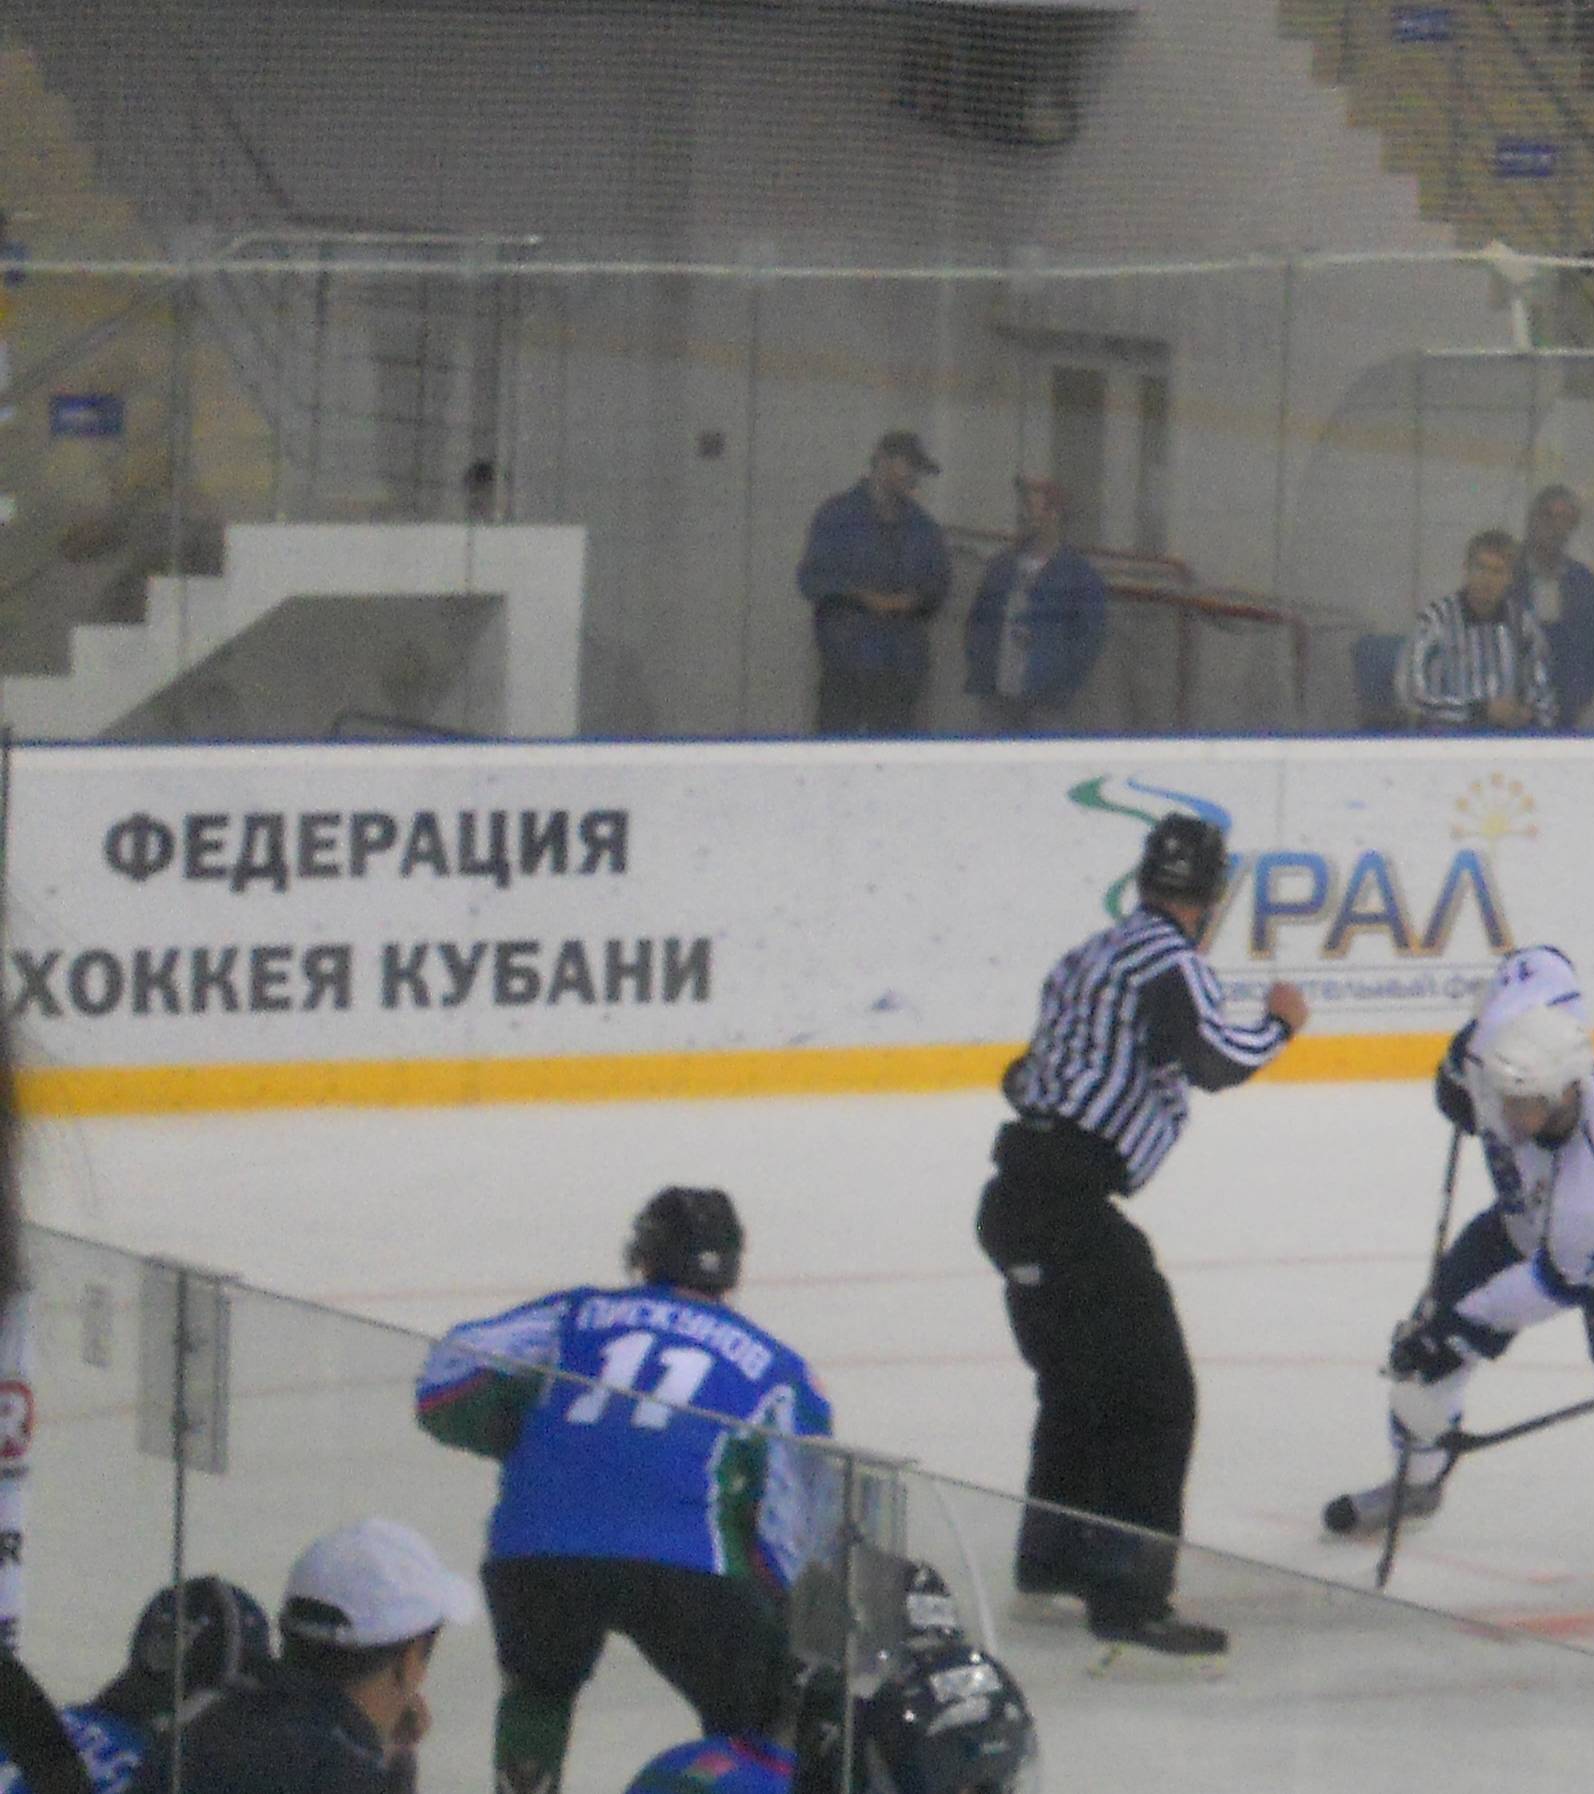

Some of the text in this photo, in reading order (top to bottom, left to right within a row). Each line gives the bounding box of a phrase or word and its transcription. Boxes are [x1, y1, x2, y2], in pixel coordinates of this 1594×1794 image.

[104, 809, 630, 892] ФЕДЕРАЦИЯ
[10, 937, 714, 1018] ХОККЕЯ КУБАНИ
[566, 1330, 713, 1430] 11
